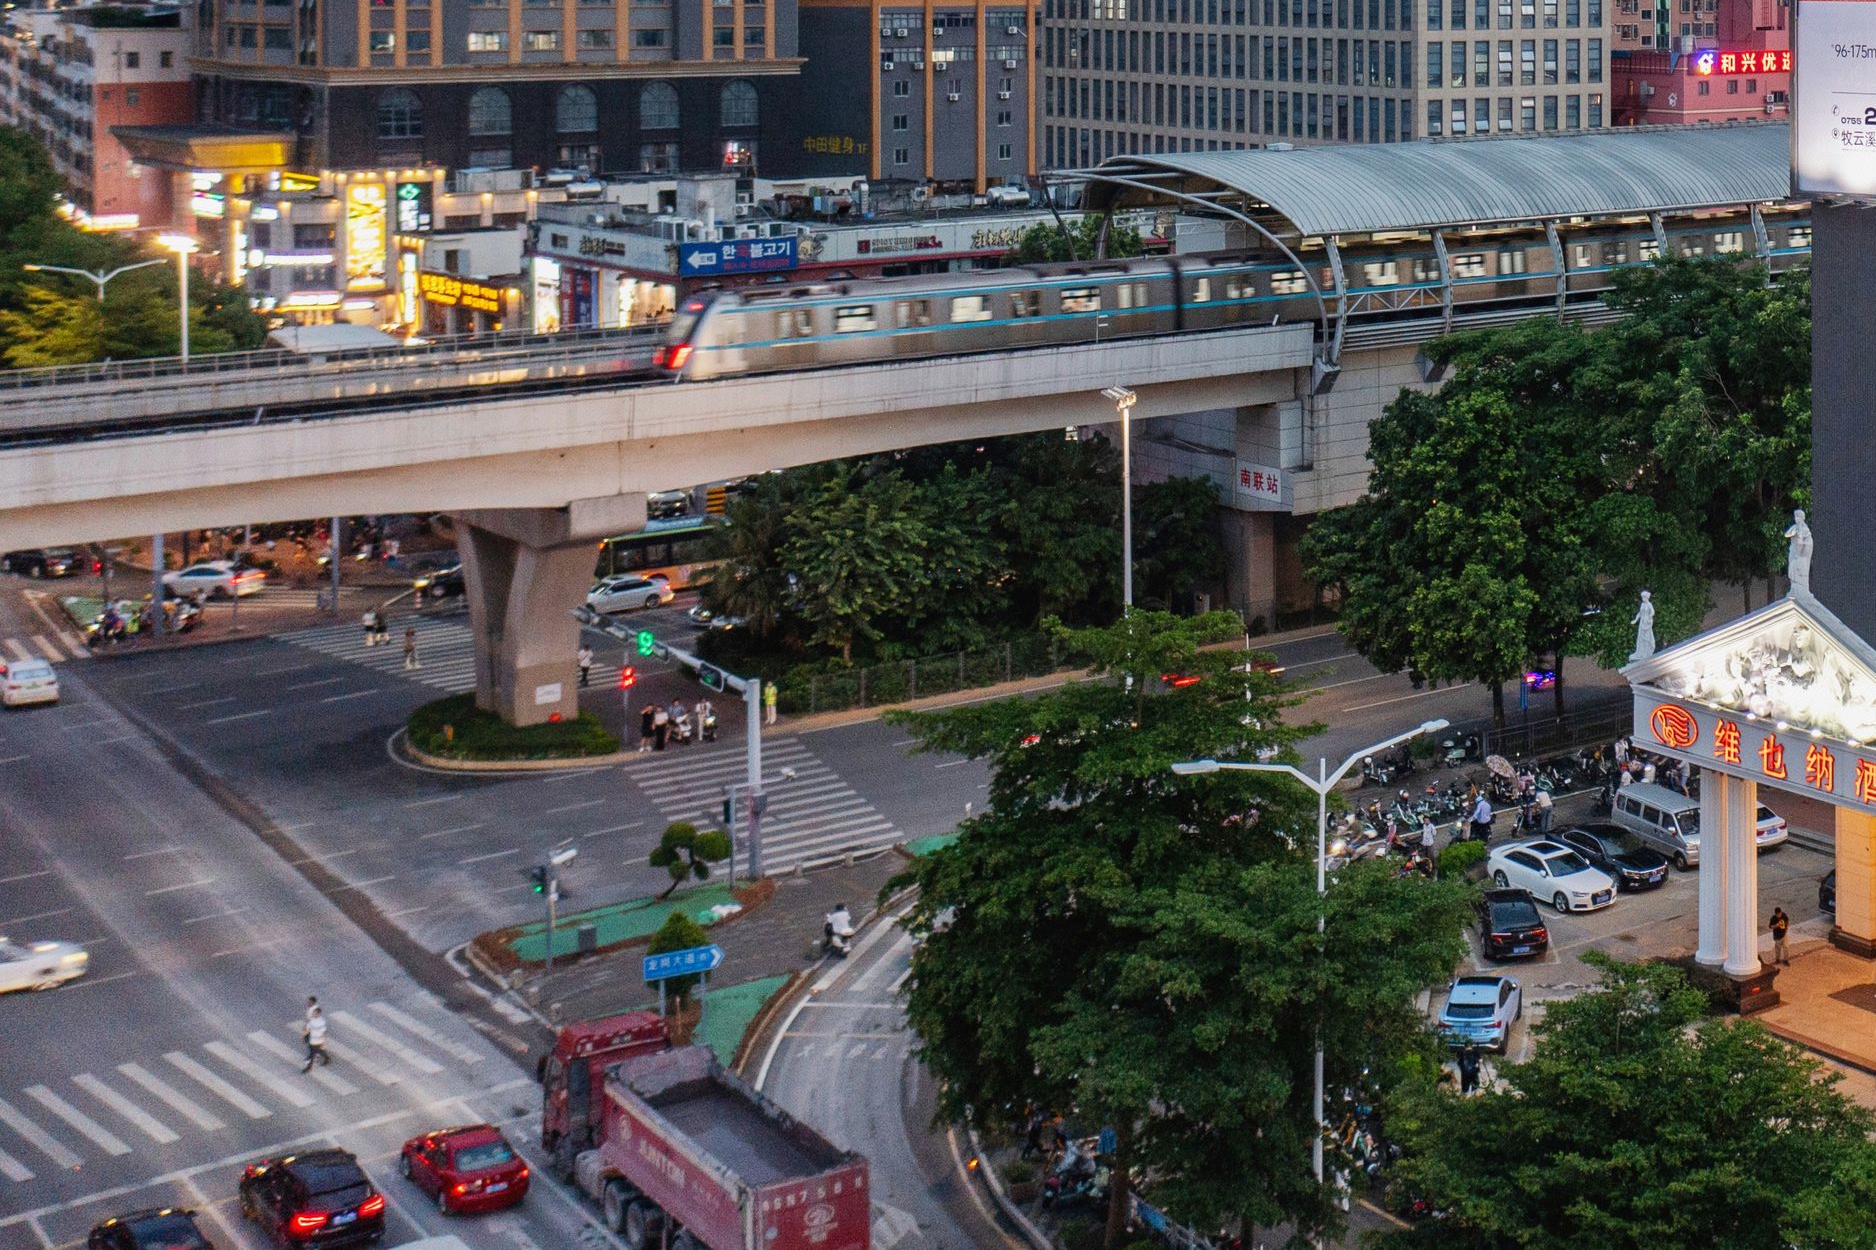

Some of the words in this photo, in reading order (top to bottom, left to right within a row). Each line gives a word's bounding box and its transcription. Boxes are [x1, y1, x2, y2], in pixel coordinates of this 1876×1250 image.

[1841, 117, 1862, 125] 0755
[1240, 468, 1278, 495] 南联站
